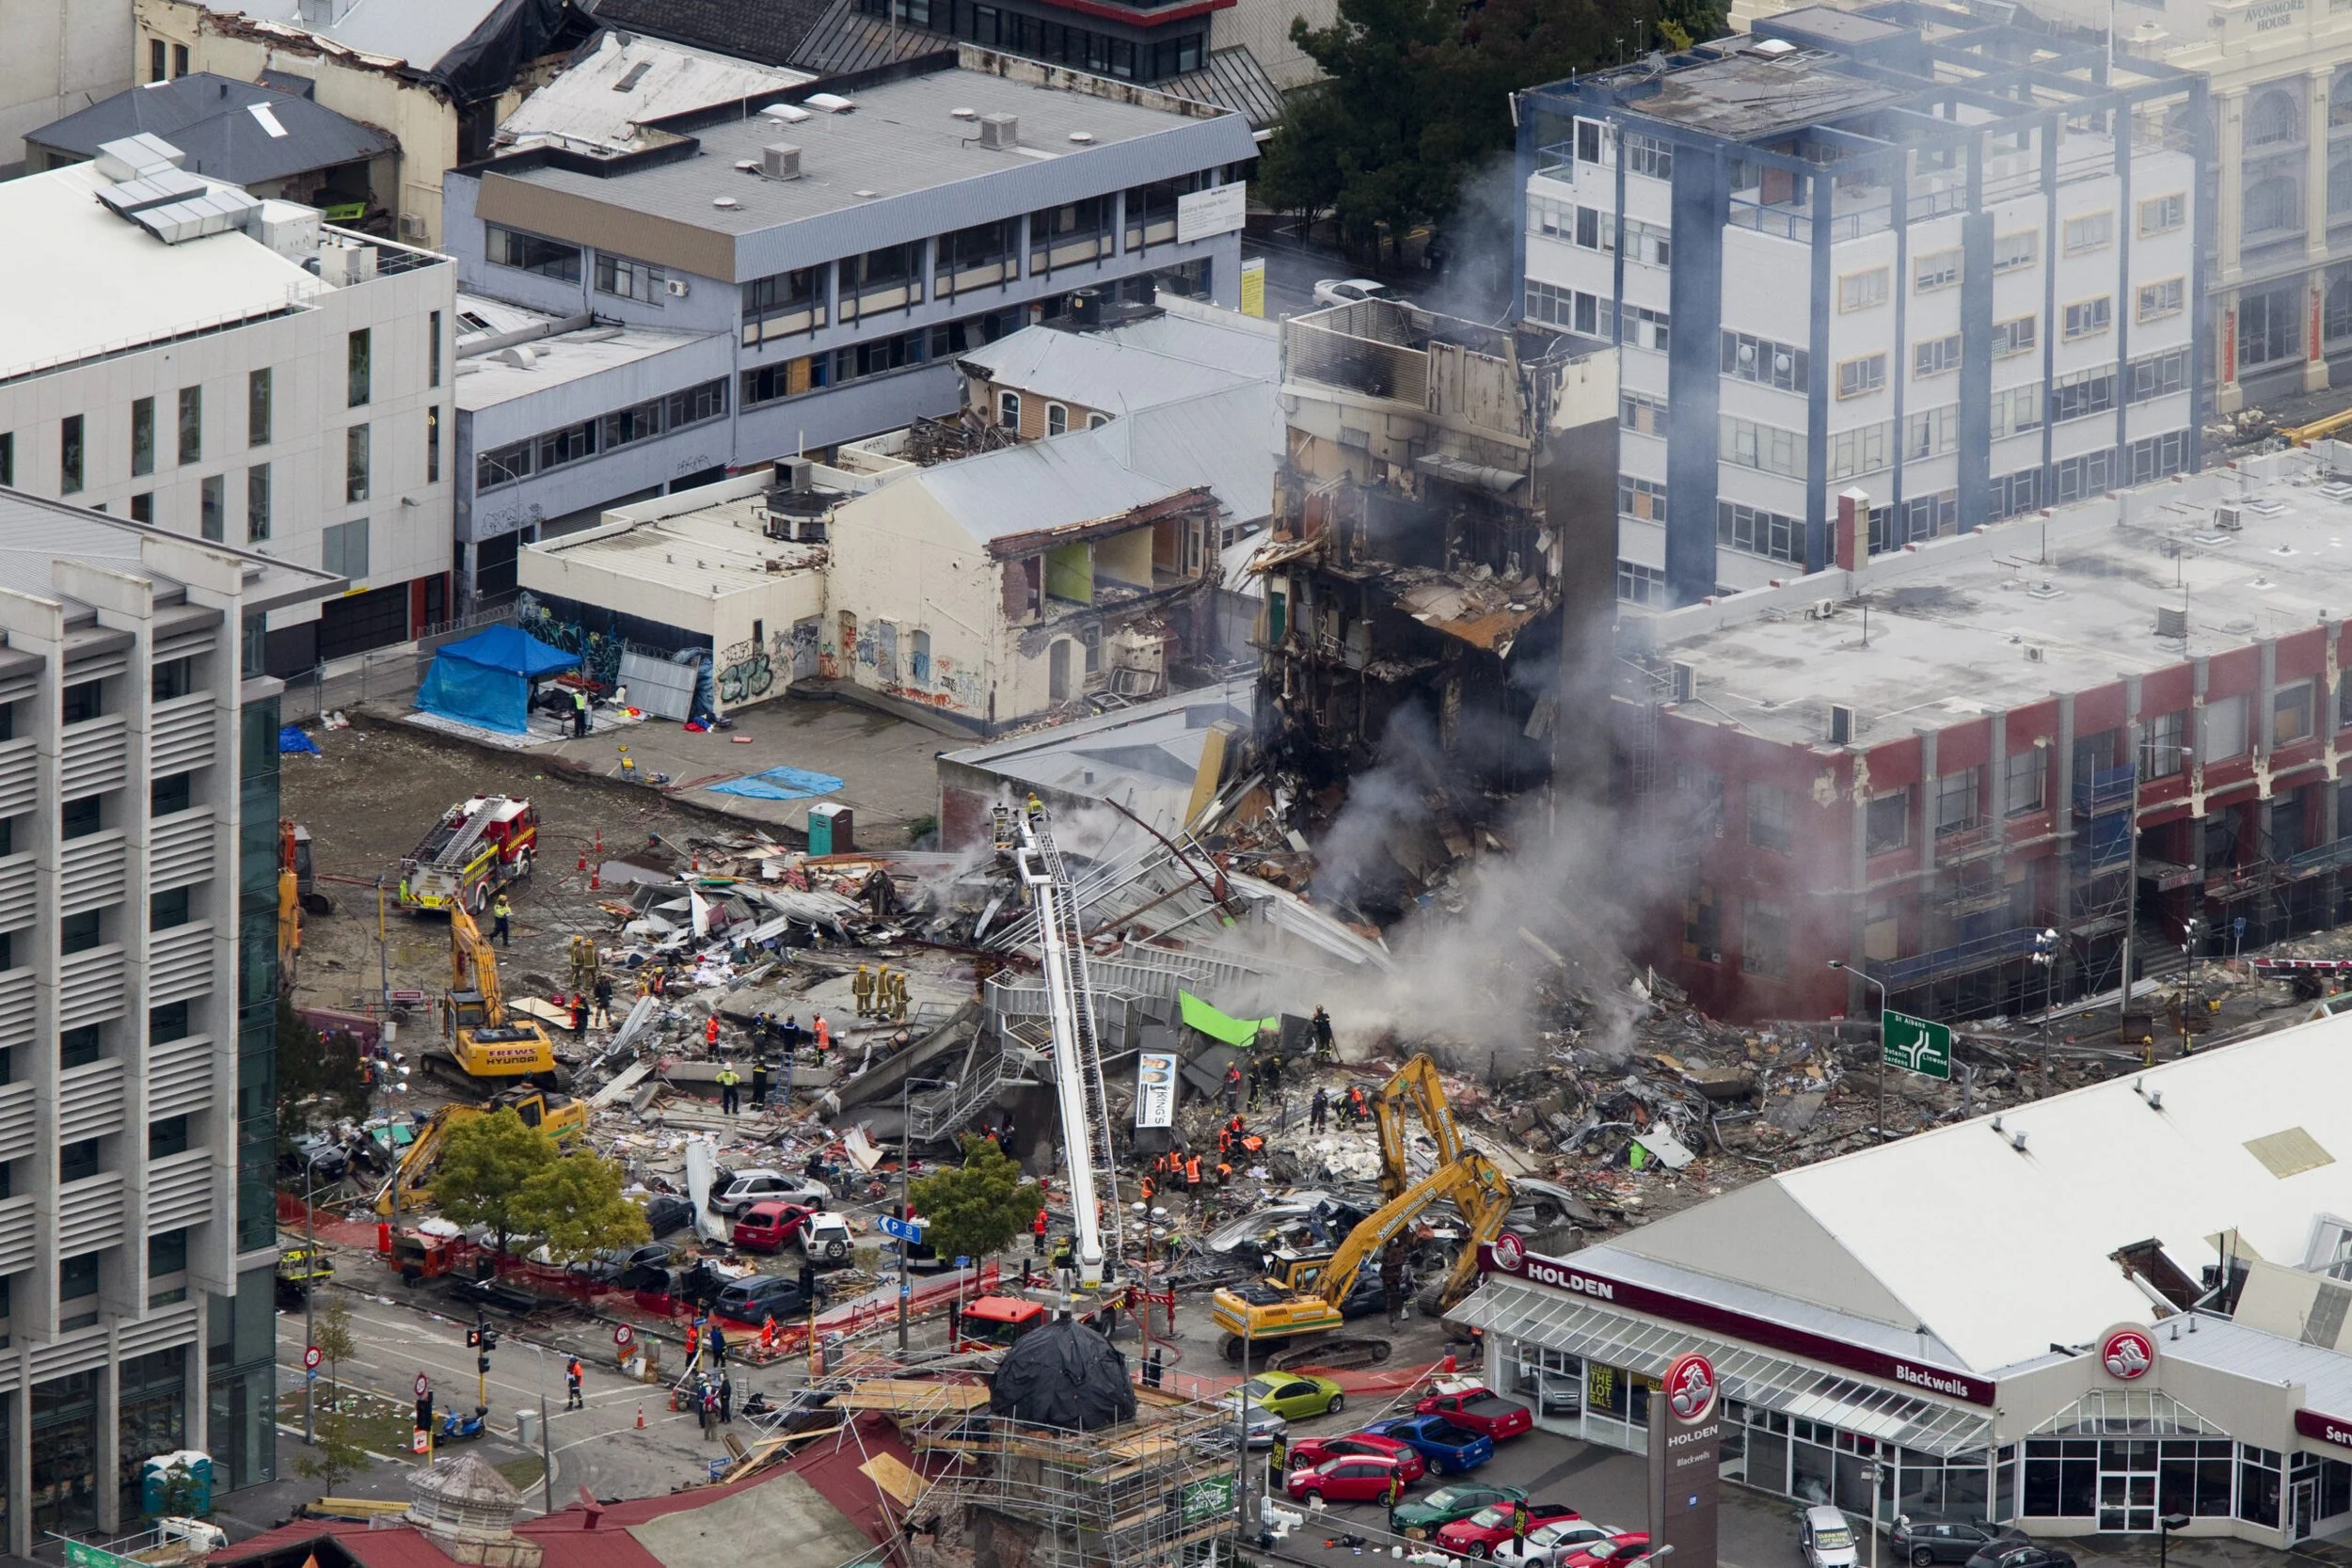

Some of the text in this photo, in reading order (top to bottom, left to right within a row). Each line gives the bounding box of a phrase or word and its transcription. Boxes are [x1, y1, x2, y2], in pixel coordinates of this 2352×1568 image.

[2244, 0, 2305, 23] AVONMORE
[2257, 13, 2292, 32] HOUSE
[1904, 1017, 1926, 1029] Albans
[1883, 1046, 1908, 1059] Botanic
[1922, 1053, 1947, 1067] Linwood
[486, 1056, 538, 1065] HYUNDAI
[1883, 1054, 1908, 1067] Gardens
[892, 1222, 898, 1231] P
[1528, 1263, 1613, 1299] HOLDEN
[619, 1329, 628, 1340] 30
[308, 1353, 318, 1362] 30
[1591, 1371, 1612, 1386] THE
[1896, 1364, 1968, 1397] Blackwells
[1590, 1382, 1612, 1399] LOT
[1590, 1394, 1612, 1409] SALE
[1668, 1424, 1719, 1447] HOLDEN
[1676, 1450, 1710, 1467] Blackwells
